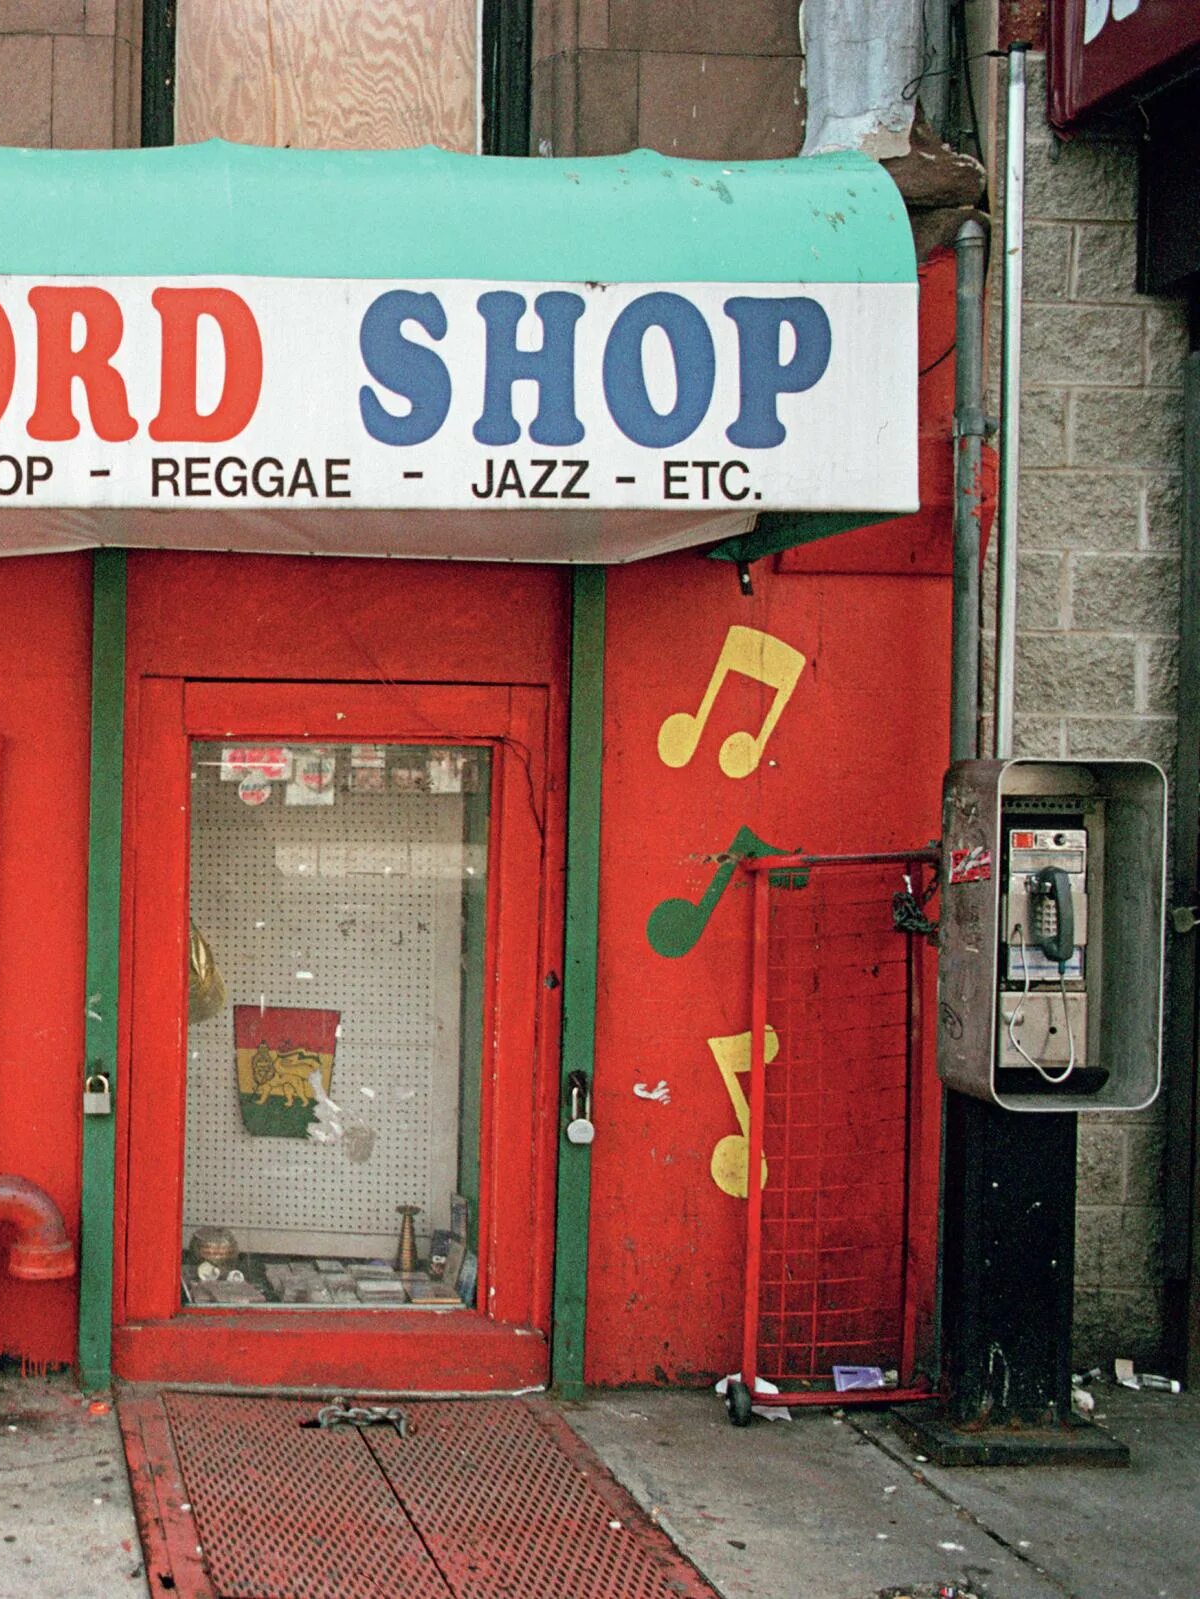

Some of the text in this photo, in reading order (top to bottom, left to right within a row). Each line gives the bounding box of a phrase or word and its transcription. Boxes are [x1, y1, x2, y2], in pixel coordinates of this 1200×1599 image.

[360, 290, 832, 449] SHOP
[151, 456, 351, 498] REGGAE
[471, 459, 590, 499] JAZZ
[663, 460, 762, 500] ETC.
